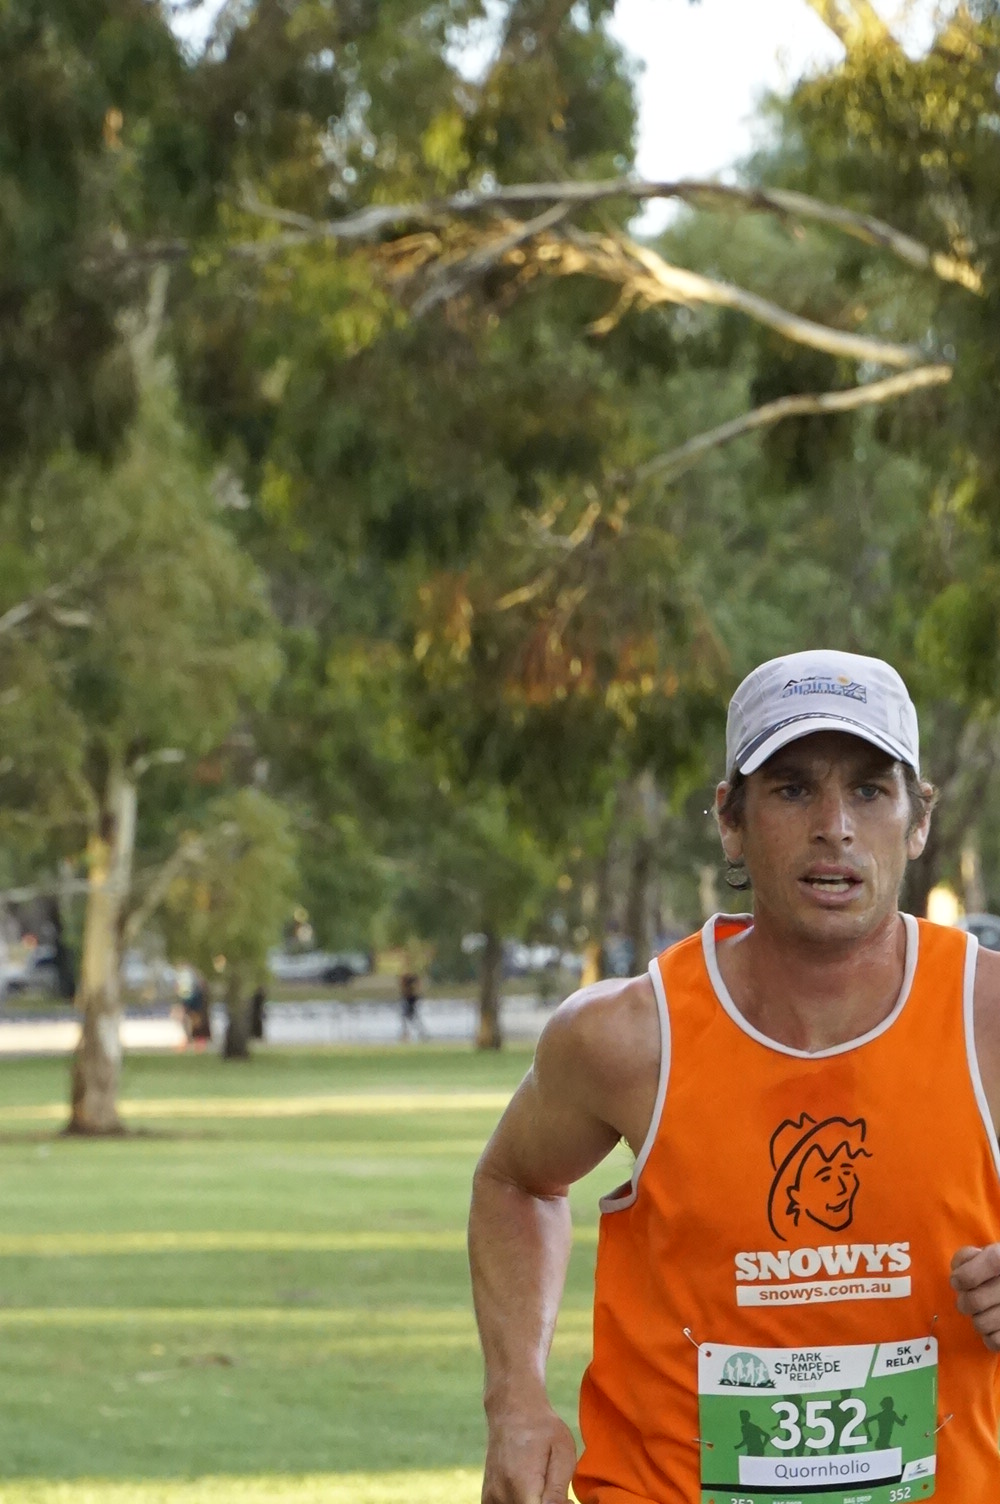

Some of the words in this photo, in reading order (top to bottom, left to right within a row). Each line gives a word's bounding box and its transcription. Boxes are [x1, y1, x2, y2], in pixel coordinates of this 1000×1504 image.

[782, 681, 842, 698] alpine
[734, 1242, 912, 1281] SNOWYS
[759, 1282, 892, 1301] snowys.com.au
[791, 1352, 822, 1363] PARK
[897, 1346, 911, 1355] 5K
[774, 1361, 841, 1374] STAMPEDE
[886, 1354, 922, 1368] RELAY
[789, 1372, 824, 1381] RELAY
[770, 1398, 868, 1450] 352
[774, 1460, 871, 1480] Quornholio
[889, 1486, 911, 1502] 352
